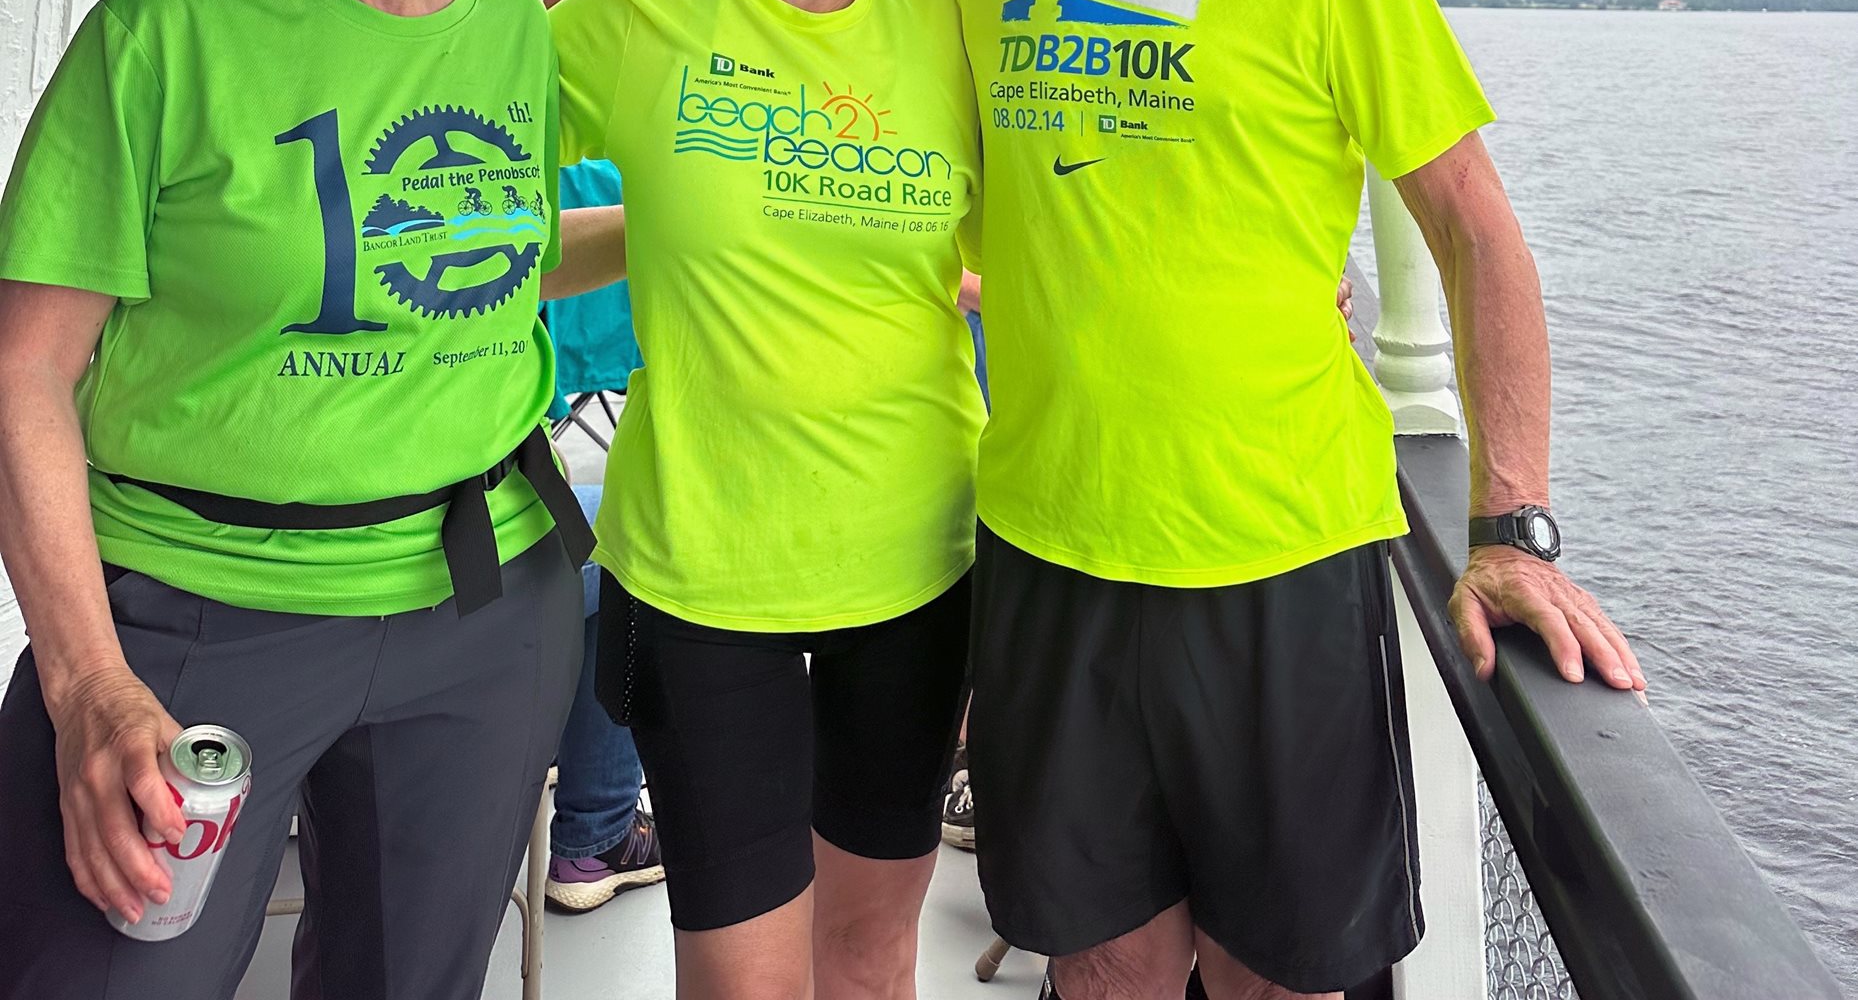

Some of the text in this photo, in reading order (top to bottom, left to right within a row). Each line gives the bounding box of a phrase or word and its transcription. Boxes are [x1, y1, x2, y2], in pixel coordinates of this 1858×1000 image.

[712, 55, 776, 79] TD Bank
[694, 77, 722, 86] America's
[723, 80, 739, 89] Most
[739, 83, 773, 94] Convenient
[989, 81, 1195, 112] Cape Elizabeth, Maine
[507, 101, 533, 124] th!
[677, 65, 833, 137] beach
[992, 107, 1065, 132] 08.02.14
[1100, 117, 1148, 131] TD Bank
[763, 131, 953, 180] beacon
[402, 164, 541, 192] Pedal the Penobscot
[762, 169, 952, 208] 10K Road Race
[762, 205, 795, 221] Cape
[798, 208, 856, 227] Elizabeth,
[860, 215, 900, 231] Maine
[491, 341, 509, 357] 11,
[277, 350, 407, 378] ANNUAL
